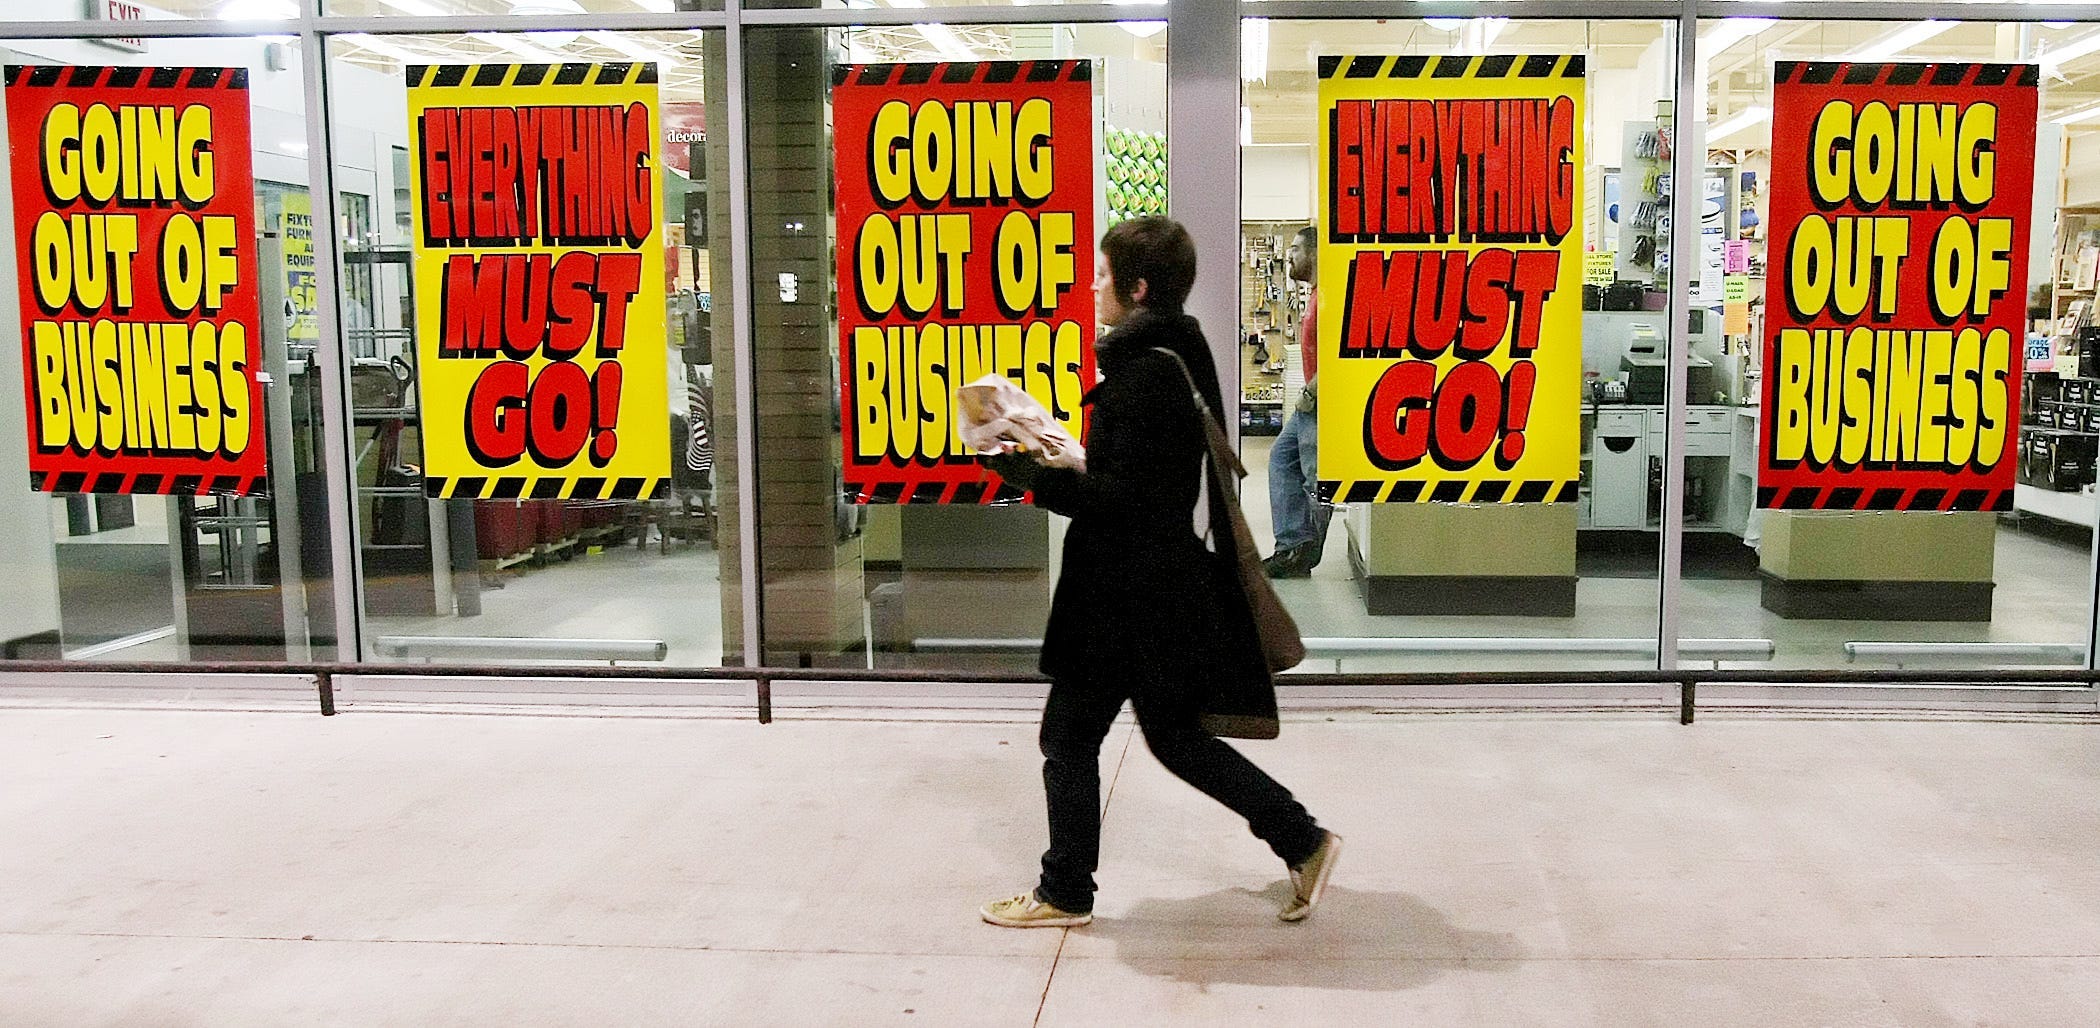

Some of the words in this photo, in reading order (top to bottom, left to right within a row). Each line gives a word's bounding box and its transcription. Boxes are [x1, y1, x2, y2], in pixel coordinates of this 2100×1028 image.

[44, 104, 214, 205] GOING
[421, 102, 651, 243] EVERYTHING
[872, 98, 1053, 205] GOING
[1334, 96, 1574, 240] EVERYTHING
[1813, 101, 1996, 206] GOING
[35, 212, 138, 311] OUT
[162, 214, 238, 312] OF
[443, 253, 641, 354] MUST
[857, 213, 971, 316] OUT
[996, 211, 1075, 314] OF
[1345, 250, 1559, 354] MUST
[1790, 215, 1909, 317] OUT
[1934, 215, 2012, 319] OF
[32, 320, 250, 456] BUSINESS
[468, 361, 621, 463] GO!
[1369, 360, 1536, 466] GO!
[1775, 327, 2010, 469] BUSINESS
